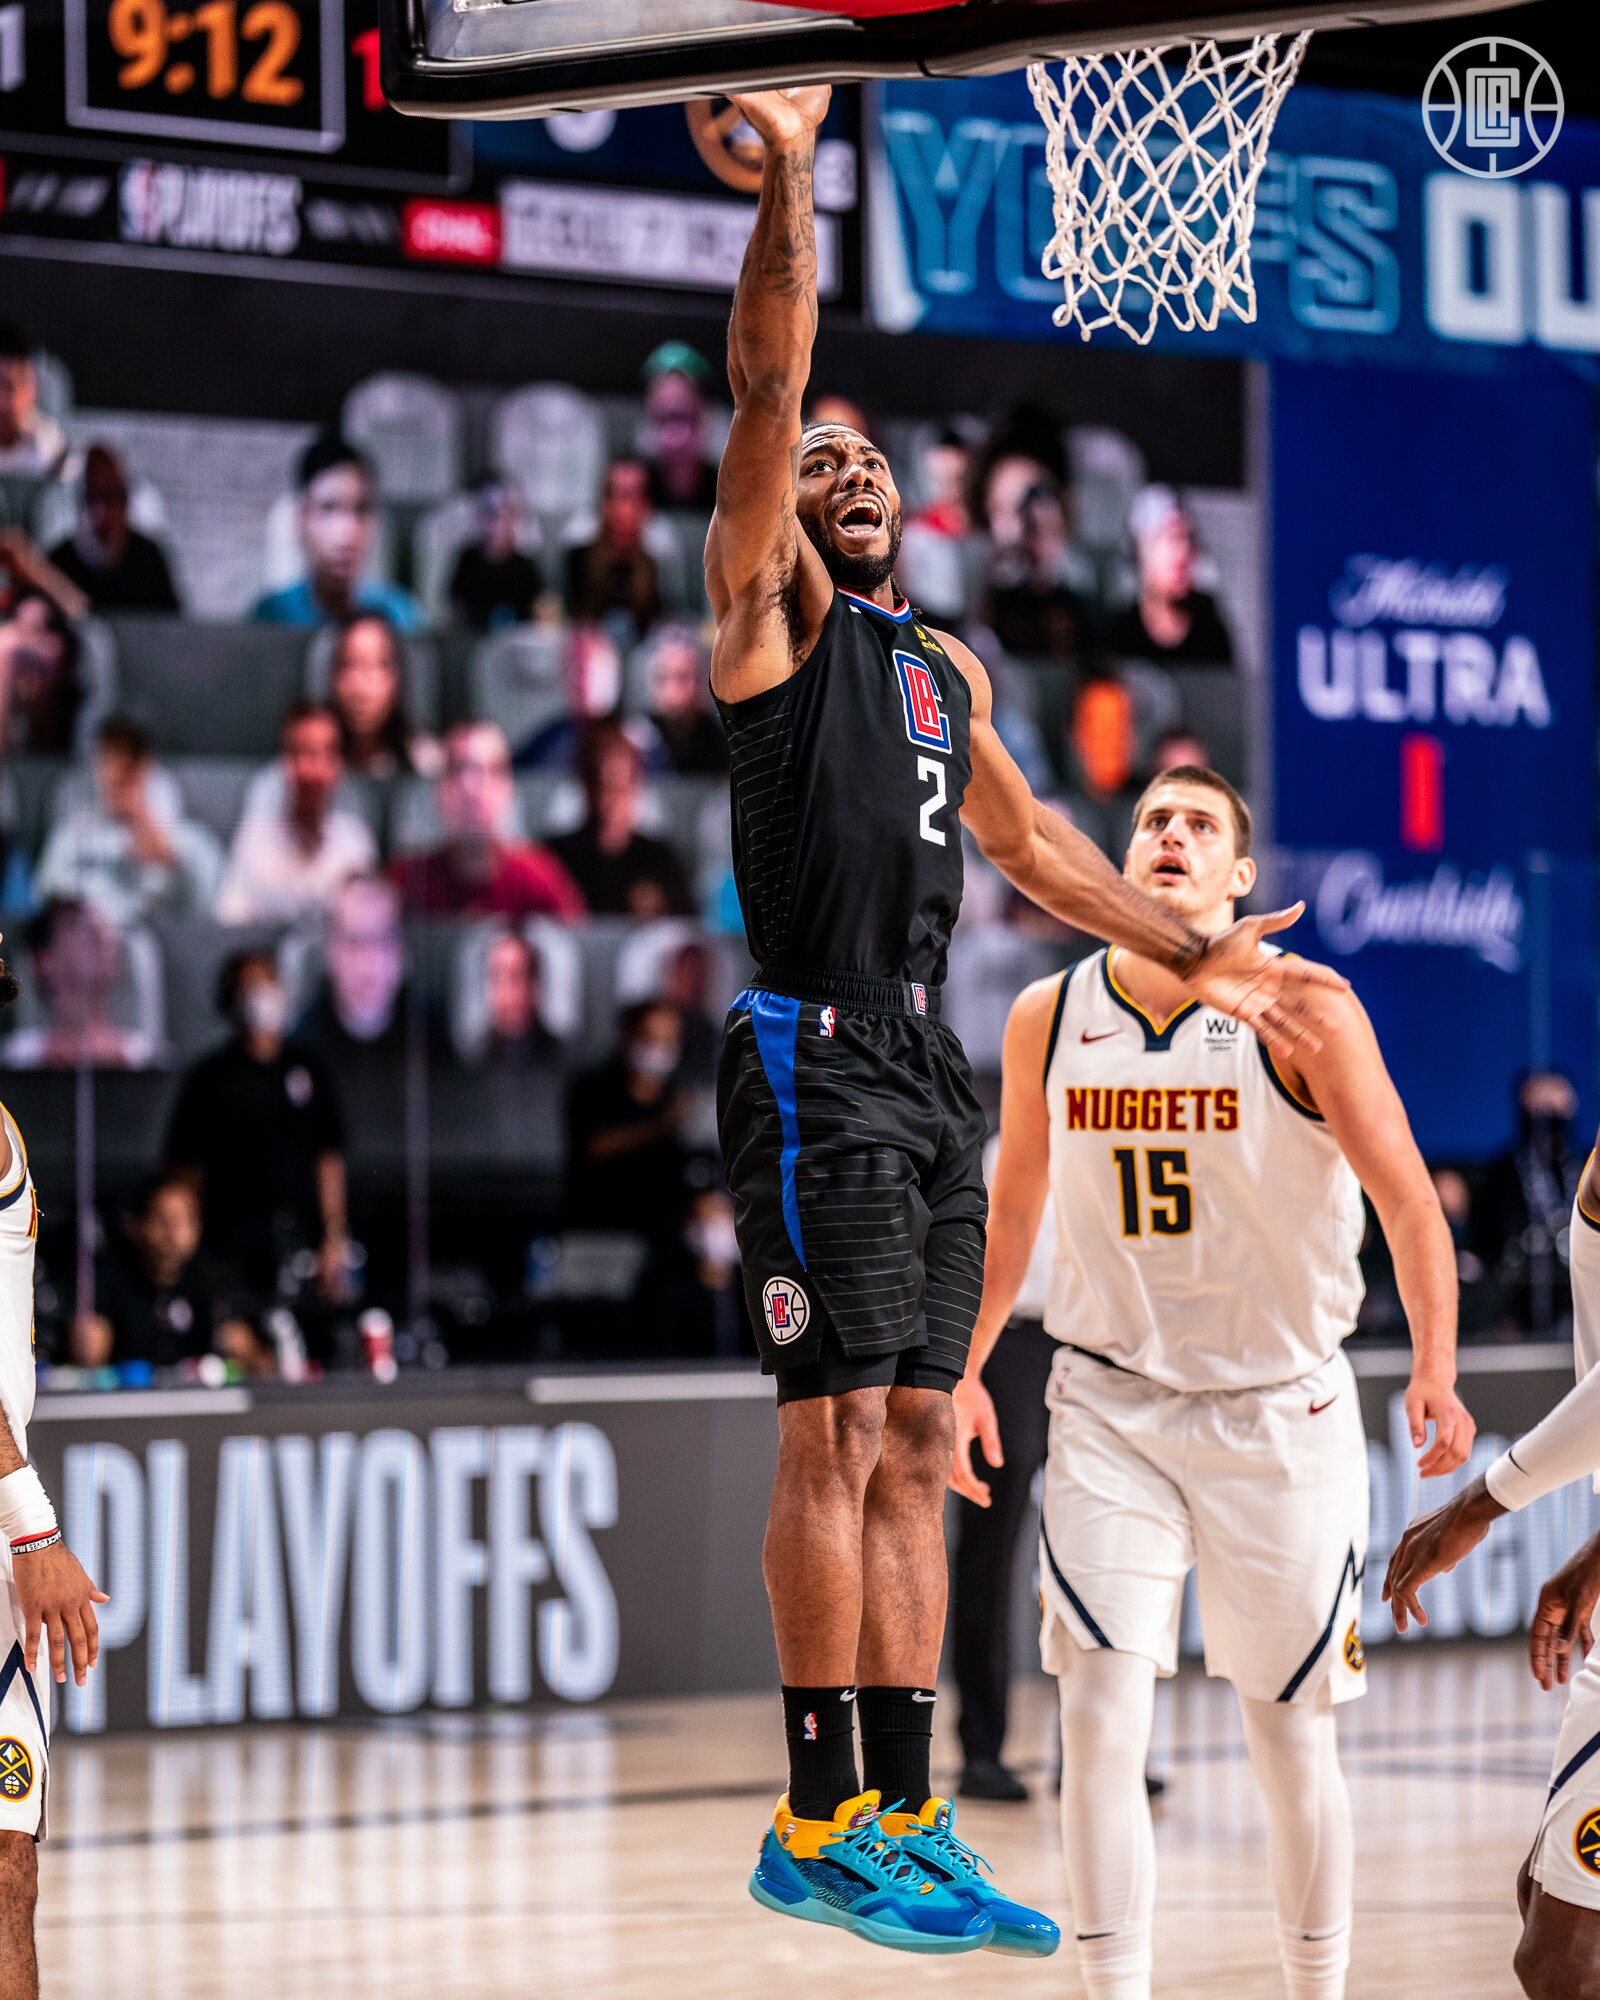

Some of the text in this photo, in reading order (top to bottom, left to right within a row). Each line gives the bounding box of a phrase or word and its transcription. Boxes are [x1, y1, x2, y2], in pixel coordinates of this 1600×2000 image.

[107, 0, 304, 106] 9:12
[1297, 622, 1555, 729] ULTRA
[917, 754, 948, 846] 2
[1206, 1018, 1239, 1035] WU
[1065, 1086, 1239, 1133] NUGGETS
[1111, 1146, 1193, 1238] 15
[64, 1420, 619, 1734] PLAYOFFS
